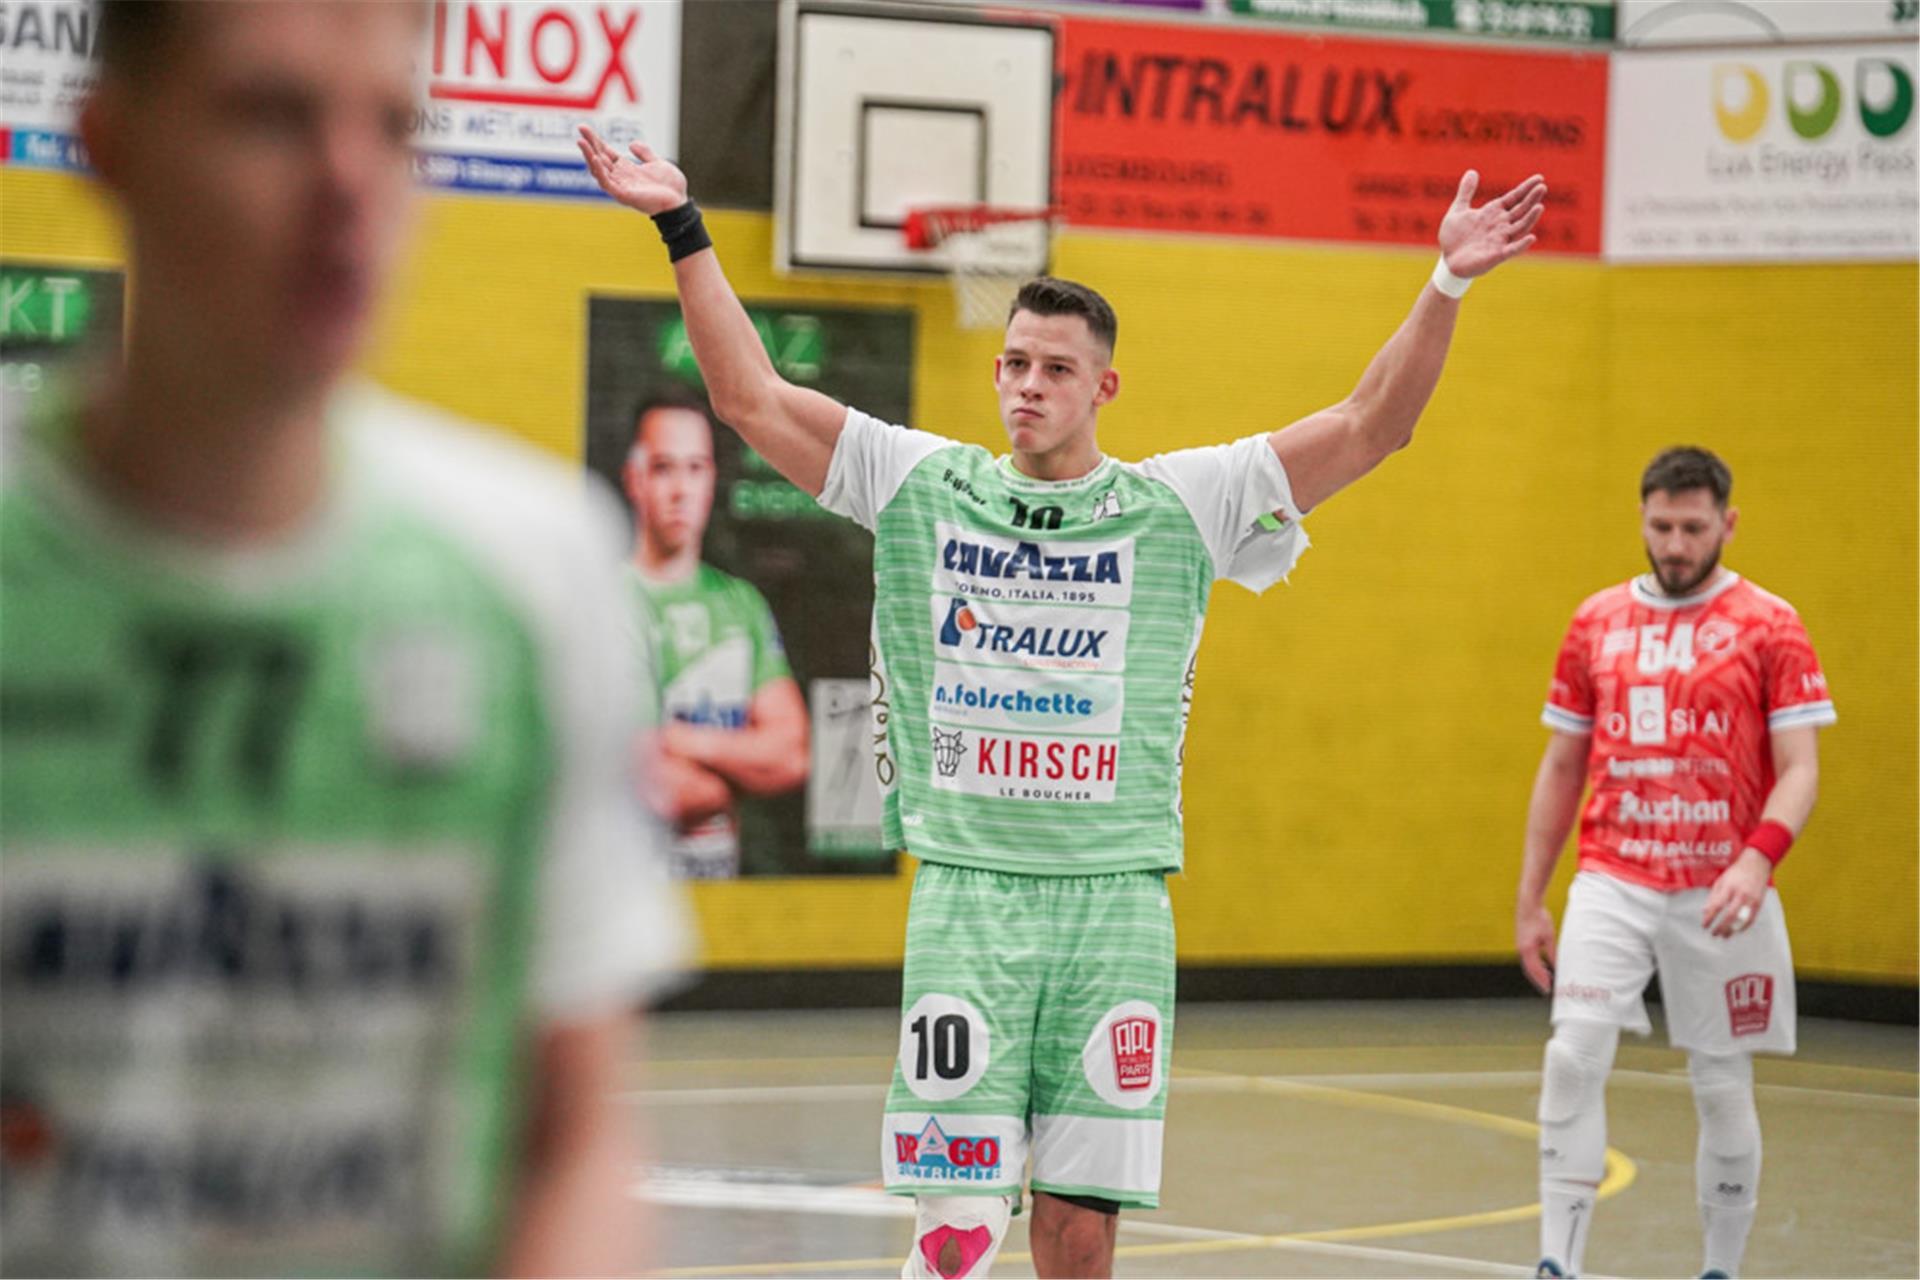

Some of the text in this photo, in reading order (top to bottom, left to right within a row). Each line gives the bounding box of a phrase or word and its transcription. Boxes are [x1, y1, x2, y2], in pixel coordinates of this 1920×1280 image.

[0, 6, 98, 58] AN
[431, 0, 639, 107] INOX
[1073, 50, 1409, 138] INTRALUX
[1063, 591, 1096, 602] 1895
[975, 622, 1109, 659] TRALUX
[1638, 623, 1697, 675] 54
[978, 737, 1117, 782] KIRSCH
[1000, 787, 1091, 801] LE BOUCHER
[1618, 790, 1730, 826] Auchan
[910, 1013, 970, 1080] 10
[1115, 1021, 1153, 1056] APL
[895, 1116, 1000, 1168] DRAGO
